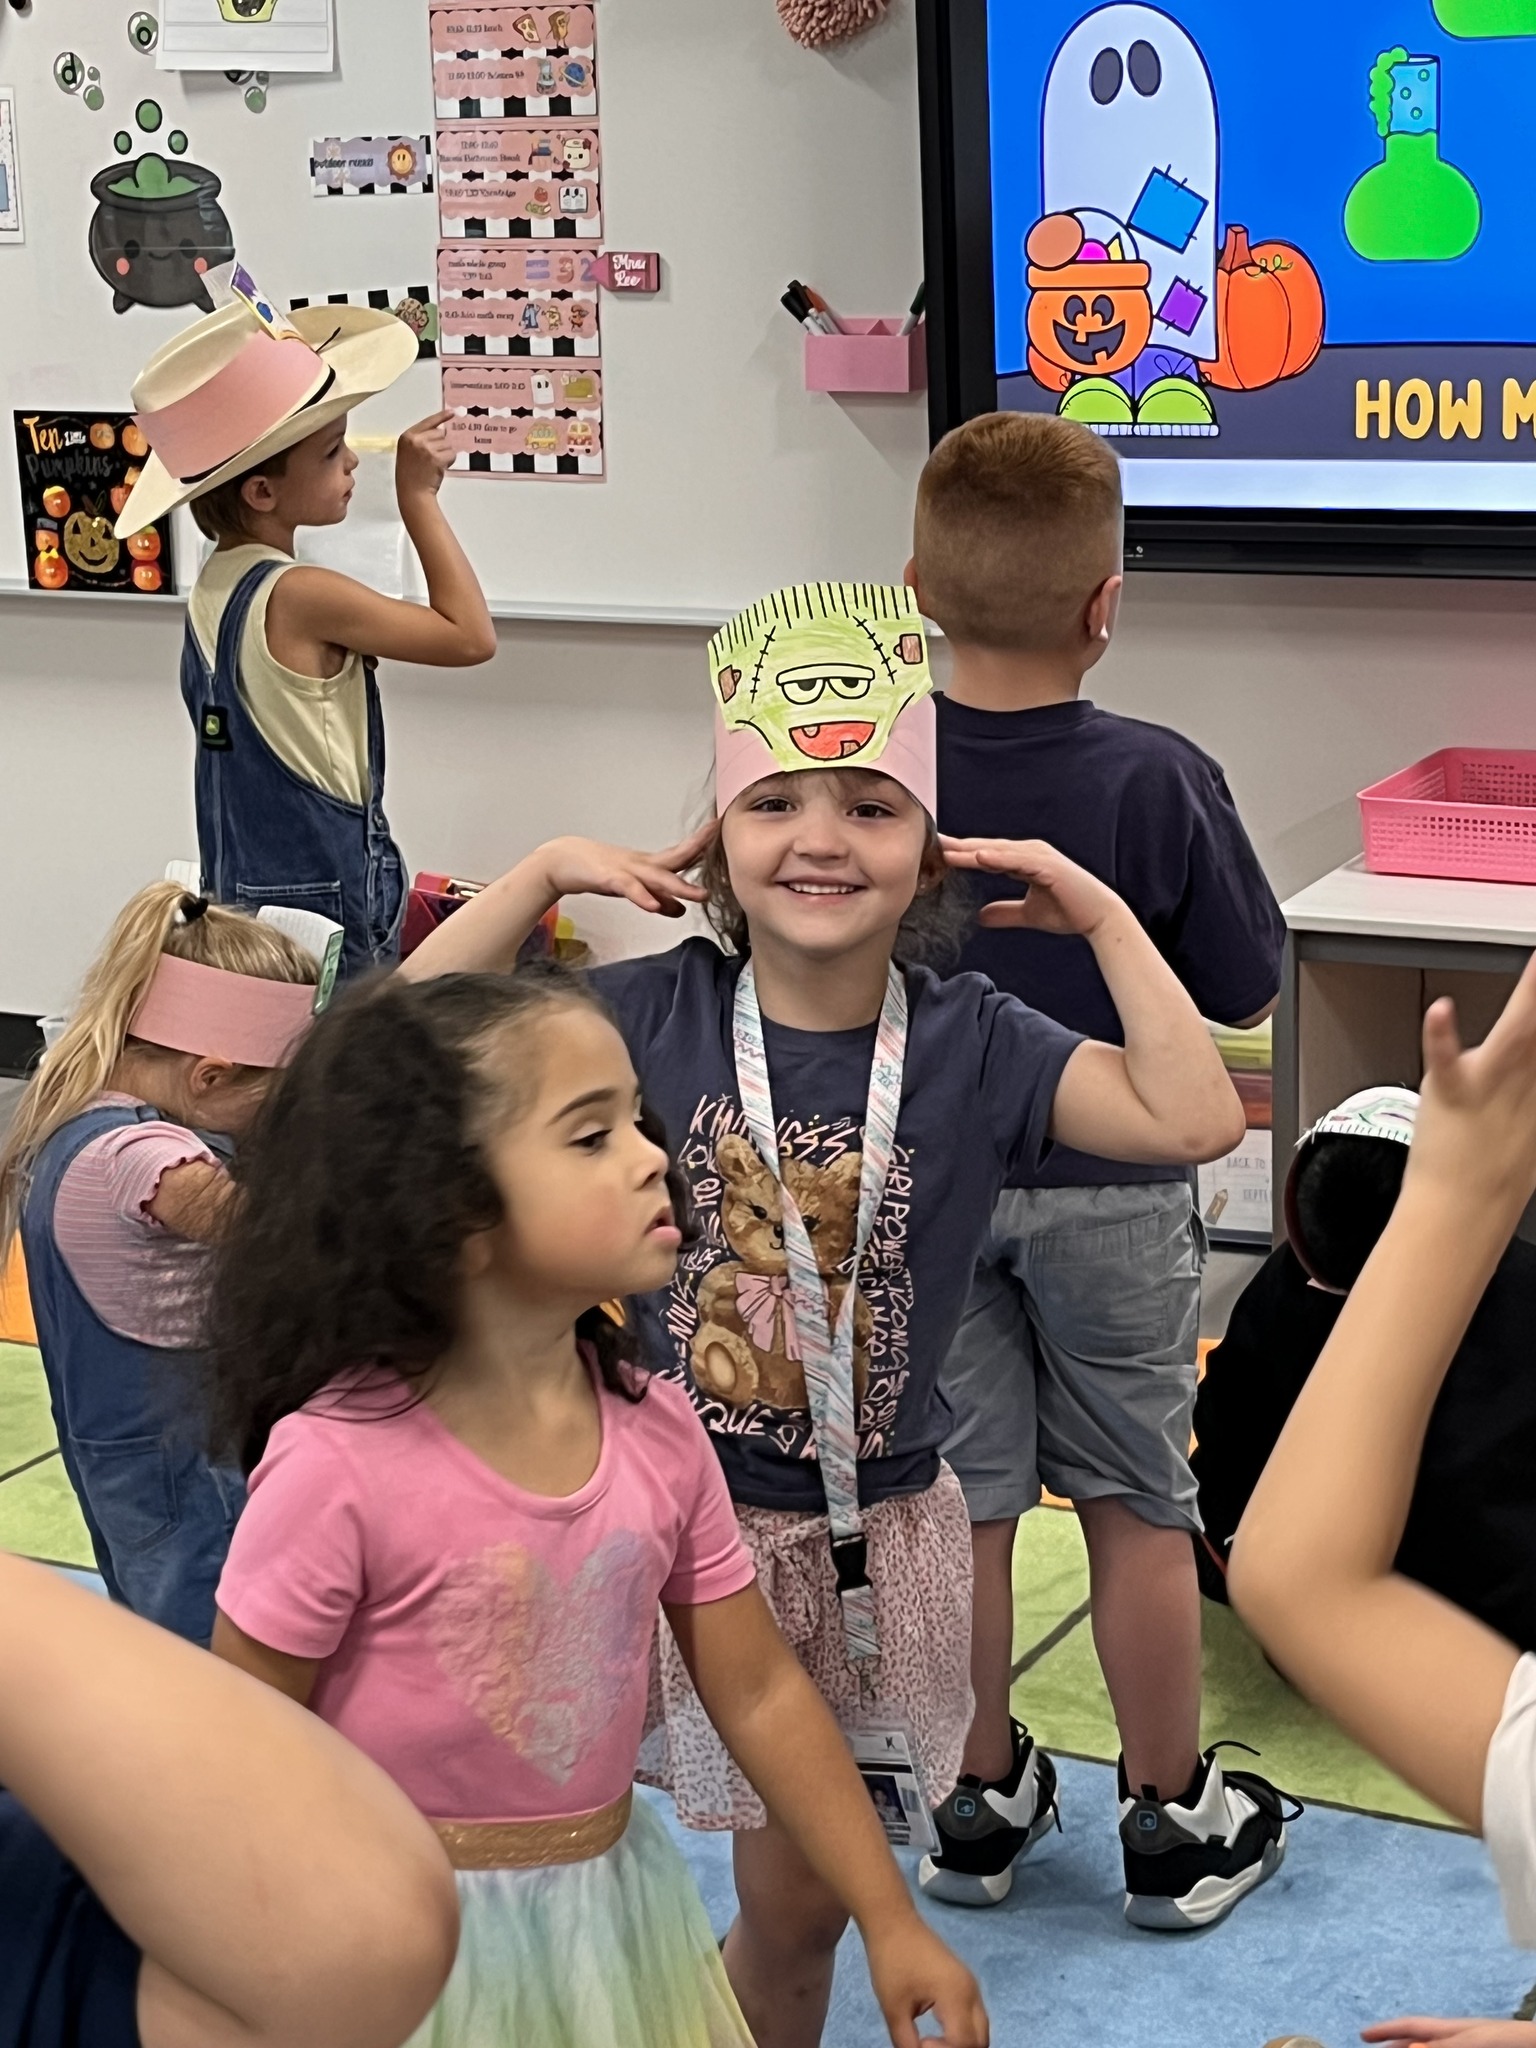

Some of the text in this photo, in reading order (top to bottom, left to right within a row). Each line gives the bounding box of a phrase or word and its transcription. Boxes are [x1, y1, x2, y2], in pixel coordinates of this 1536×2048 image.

[1355, 377, 1482, 440] HOW
[23, 416, 63, 455] Ten
[25, 448, 113, 484] Pumpkins
